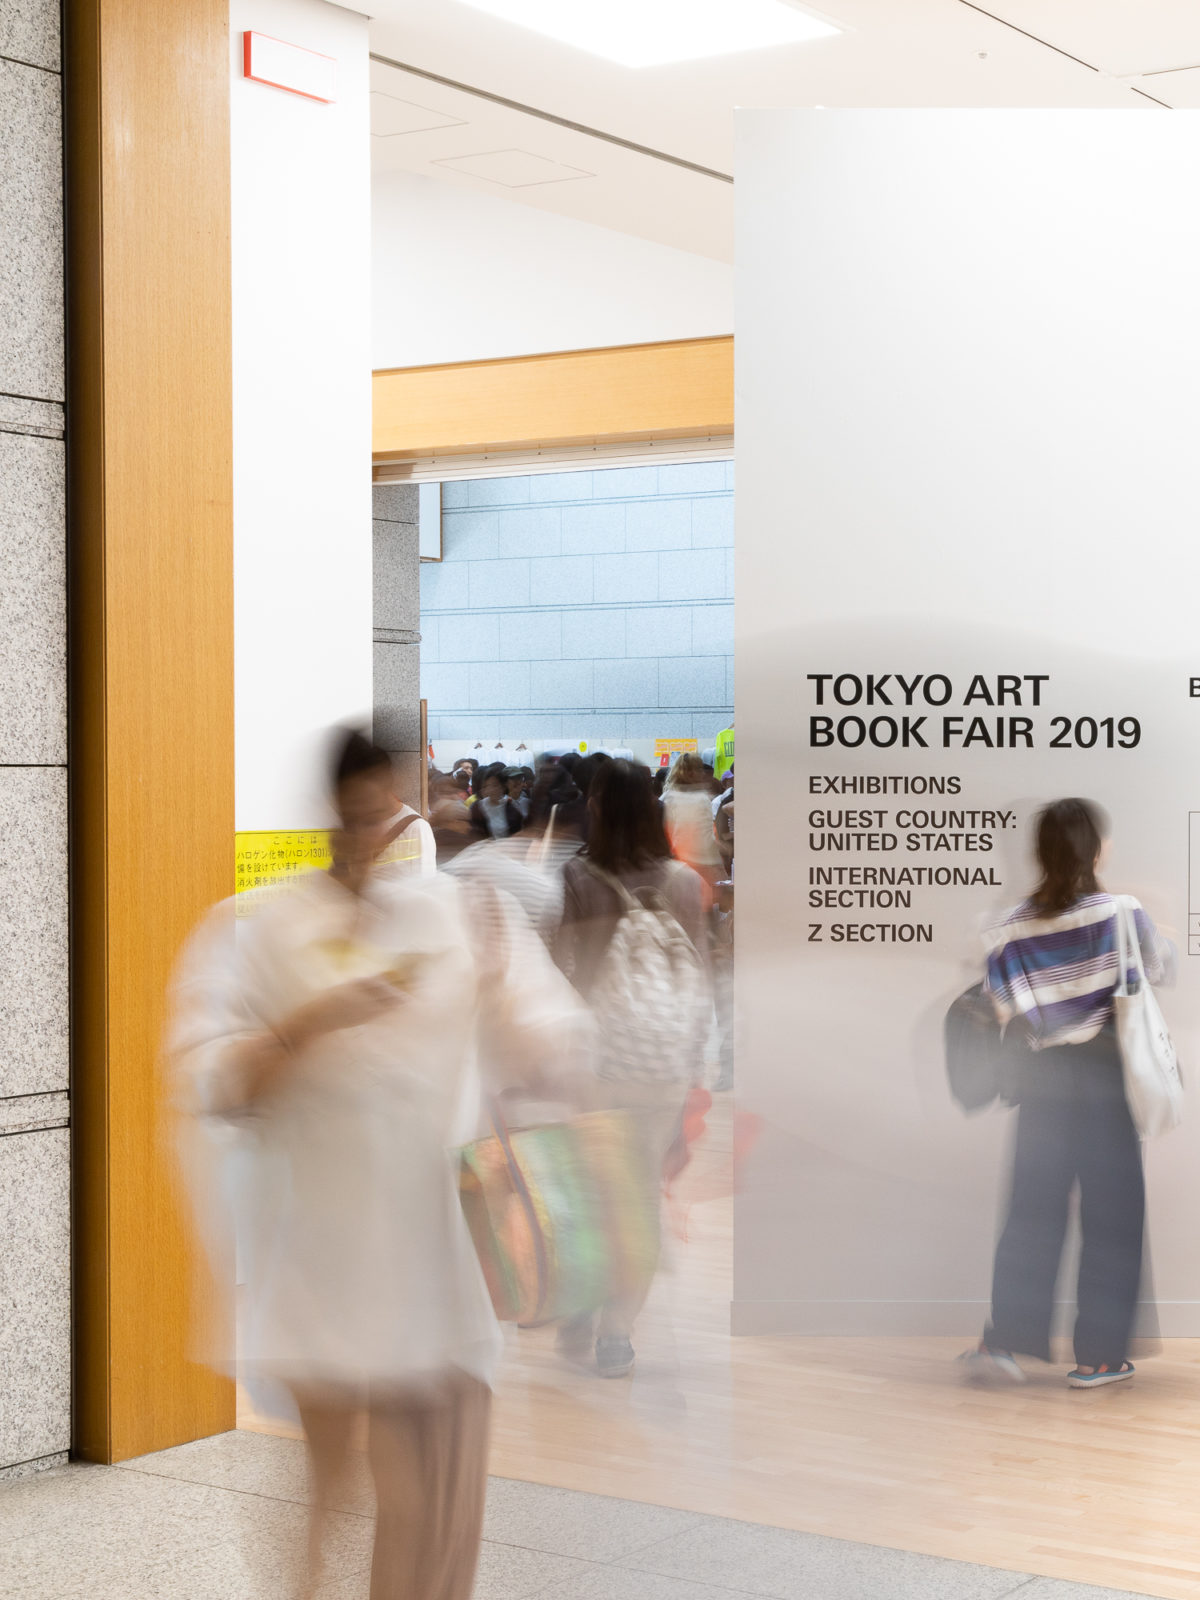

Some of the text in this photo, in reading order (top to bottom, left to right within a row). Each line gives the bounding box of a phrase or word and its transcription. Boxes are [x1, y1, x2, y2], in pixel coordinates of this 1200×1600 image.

[807, 673, 1050, 706] TOKYO ART
[809, 715, 1142, 749] BOOK FAIR 2019
[808, 775, 962, 795] EXHIBITIONS
[808, 810, 1017, 829] GUEST COUNTRY:
[808, 832, 994, 852] UNITED STATES
[808, 866, 1002, 886] INTERNATIONAL
[808, 889, 912, 909] SECTION
[808, 923, 933, 943] Z SECTION
